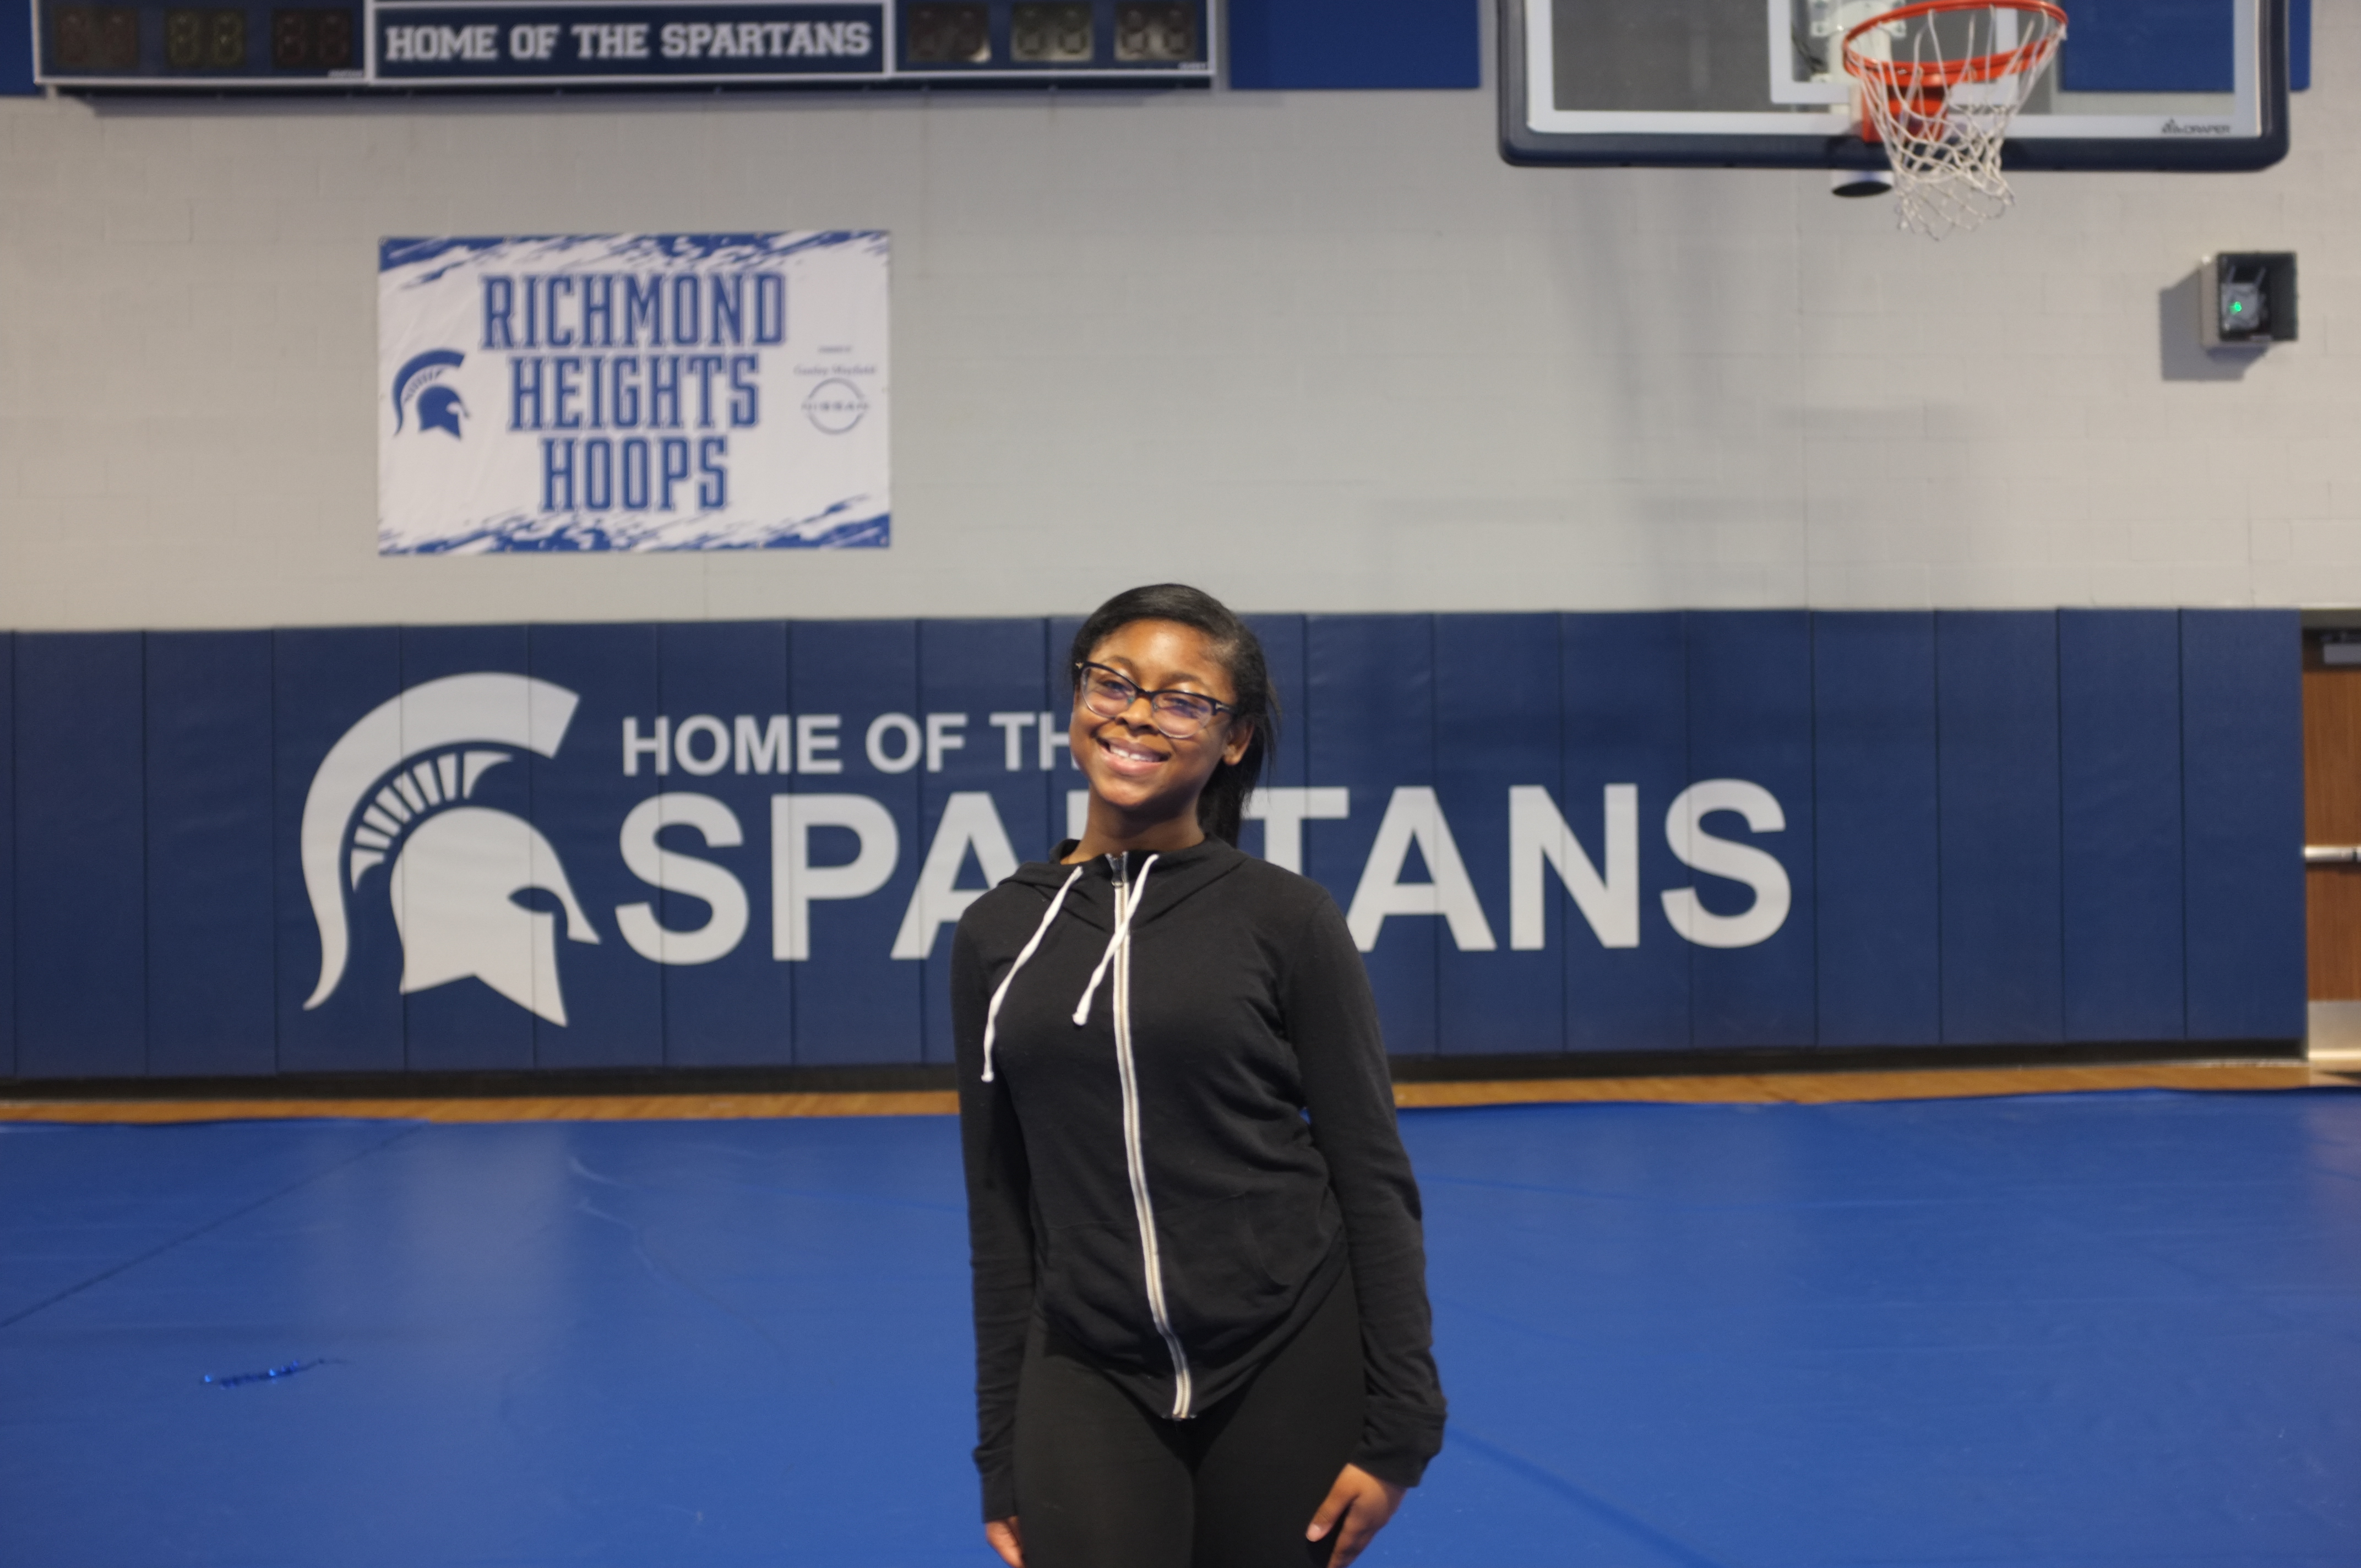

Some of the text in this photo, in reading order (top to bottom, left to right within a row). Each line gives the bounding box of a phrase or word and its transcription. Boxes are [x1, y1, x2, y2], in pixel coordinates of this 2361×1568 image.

[384, 20, 872, 61] HOME OF THE SPARTANS
[479, 270, 787, 351] RICHMOND
[506, 352, 760, 433] HEIGHTS
[540, 435, 728, 513] HOOPS
[622, 711, 1084, 776] HOME OF TH
[614, 777, 1792, 965] SPATANS
